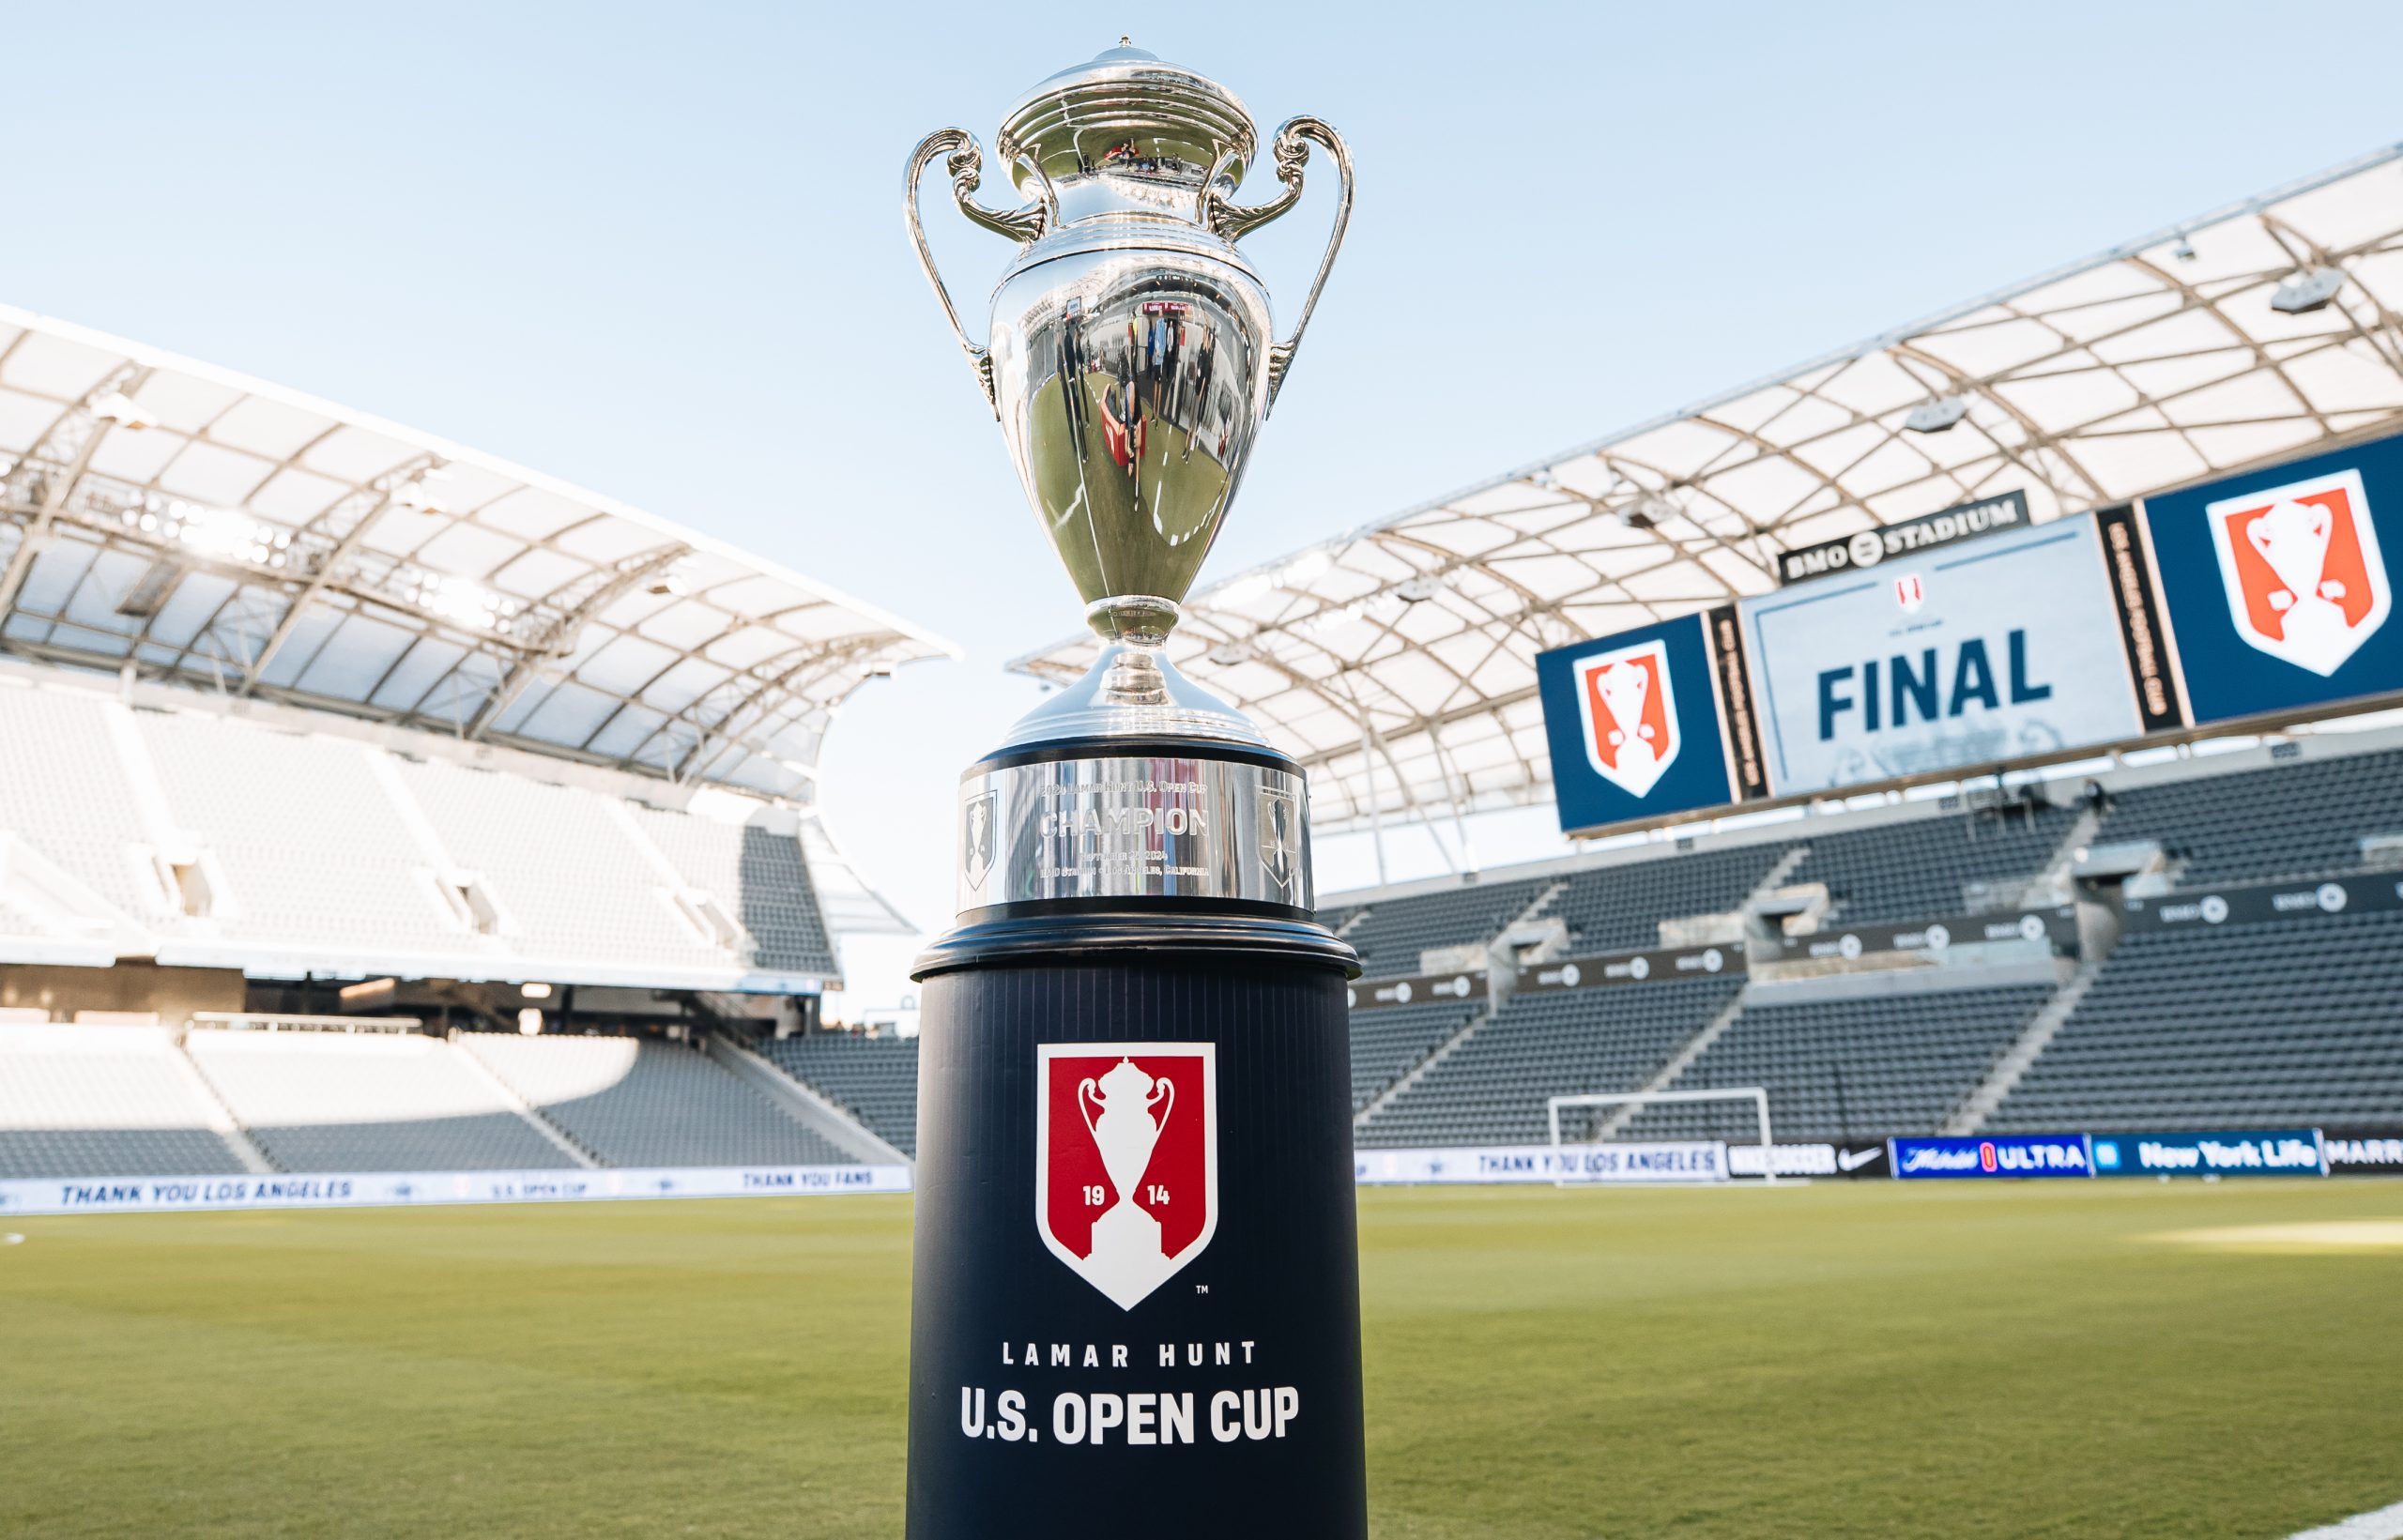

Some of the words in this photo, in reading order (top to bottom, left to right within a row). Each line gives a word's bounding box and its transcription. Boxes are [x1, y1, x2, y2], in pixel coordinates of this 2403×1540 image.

[1785, 545, 1849, 579] BMO
[1883, 499, 2018, 554] STADIUM
[1817, 628, 2052, 741] FINAL
[1040, 784, 1066, 797] 2024
[1105, 781, 1133, 792] HUNT
[1136, 781, 1157, 793] U.S.
[1159, 781, 1186, 793] OPEN
[1188, 782, 1208, 794] CUP
[1039, 807, 1209, 838] CHAMPION
[1479, 1154, 1535, 1171] THANK
[1584, 1153, 1618, 1172] LOS
[1627, 1151, 1717, 1171] ANGELES
[1997, 1144, 2087, 1169] ULTRA
[2138, 1141, 2199, 1168] New
[2197, 1140, 2262, 1168] York
[2261, 1139, 2317, 1167] Life
[61, 1184, 143, 1205] THANK
[152, 1183, 199, 1203] YOU
[204, 1182, 246, 1201] LOS
[254, 1180, 353, 1200] ANGELES
[743, 1172, 793, 1188] THANK
[1083, 1185, 1105, 1205] 19
[1147, 1184, 1170, 1205] 14
[1003, 1342, 1127, 1367] LAMAR
[1159, 1341, 1255, 1366] HUNT
[961, 1386, 1038, 1442] U.S.
[1052, 1392, 1194, 1445] OPEN
[1210, 1386, 1299, 1442] CUP
